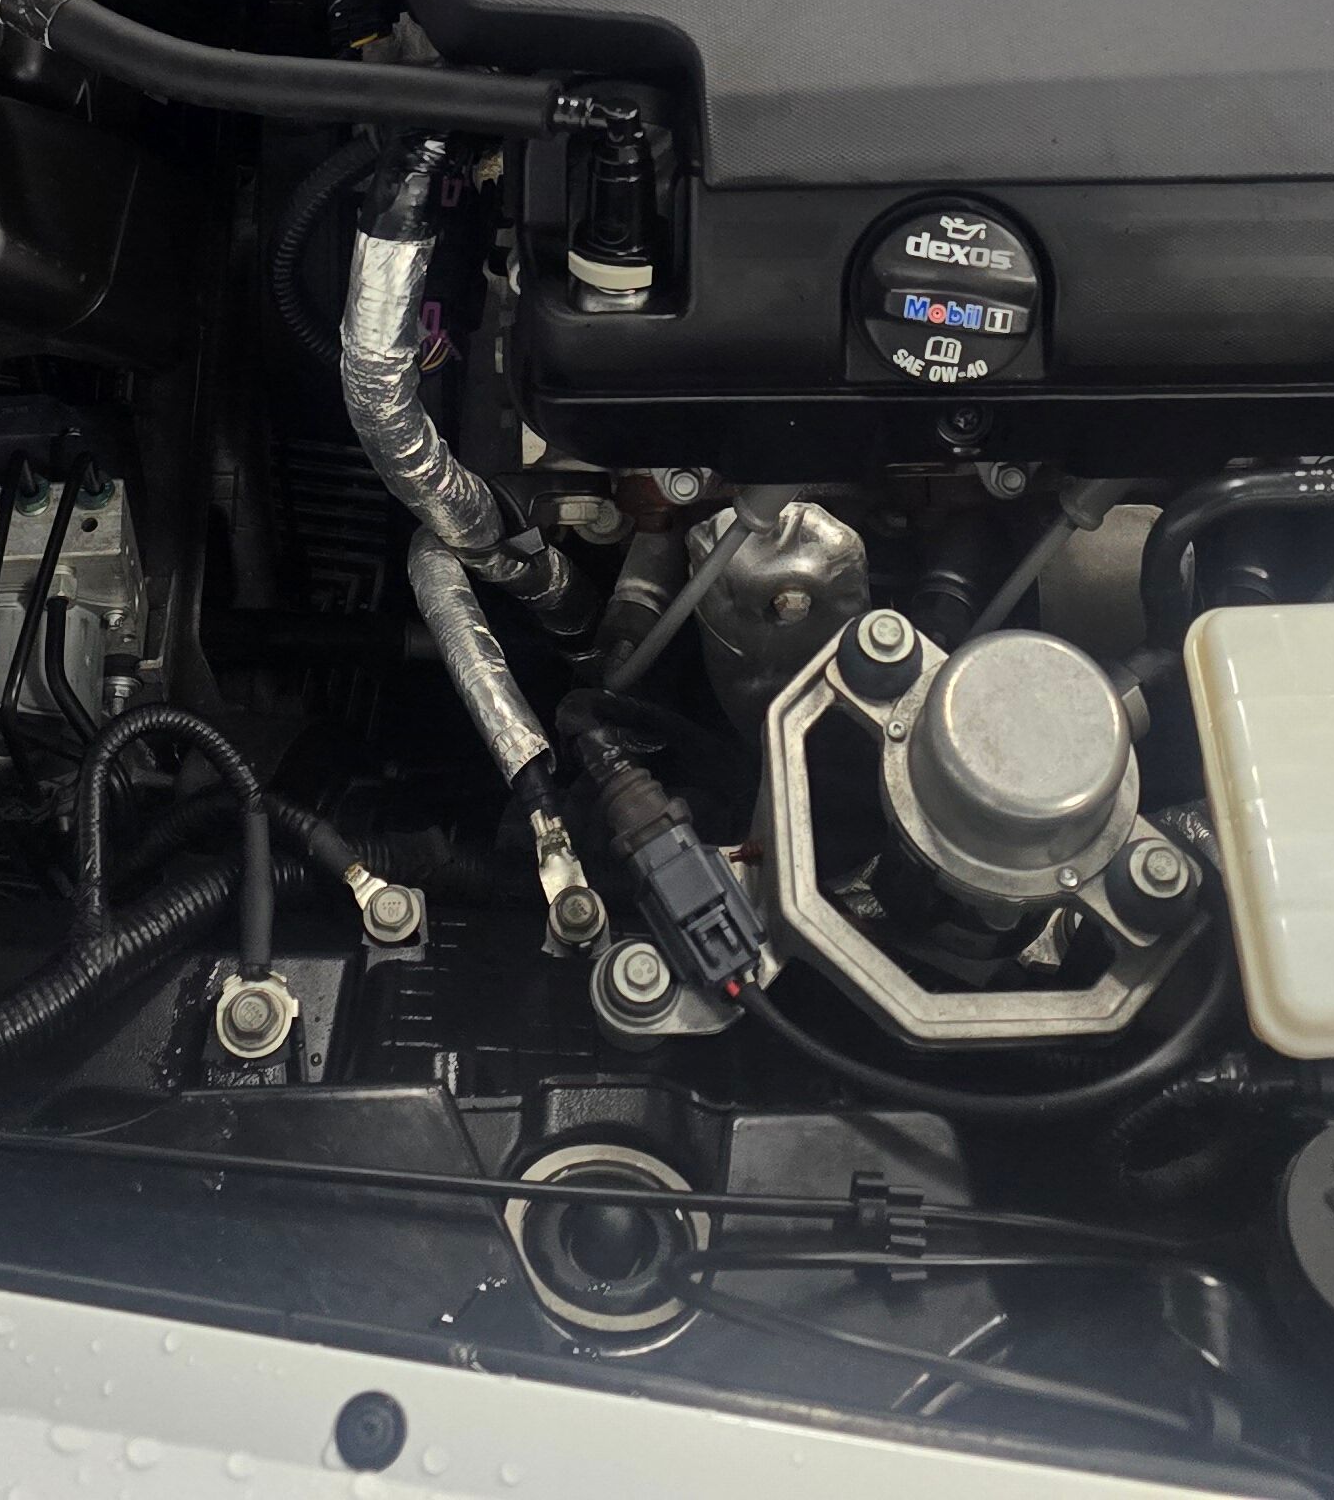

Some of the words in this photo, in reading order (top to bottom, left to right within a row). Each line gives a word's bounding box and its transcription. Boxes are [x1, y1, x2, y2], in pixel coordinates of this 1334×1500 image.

[905, 232, 1015, 270] dexos
[903, 294, 984, 330] Mobil
[892, 348, 926, 377] SAE
[929, 359, 989, 383] 0W-40
